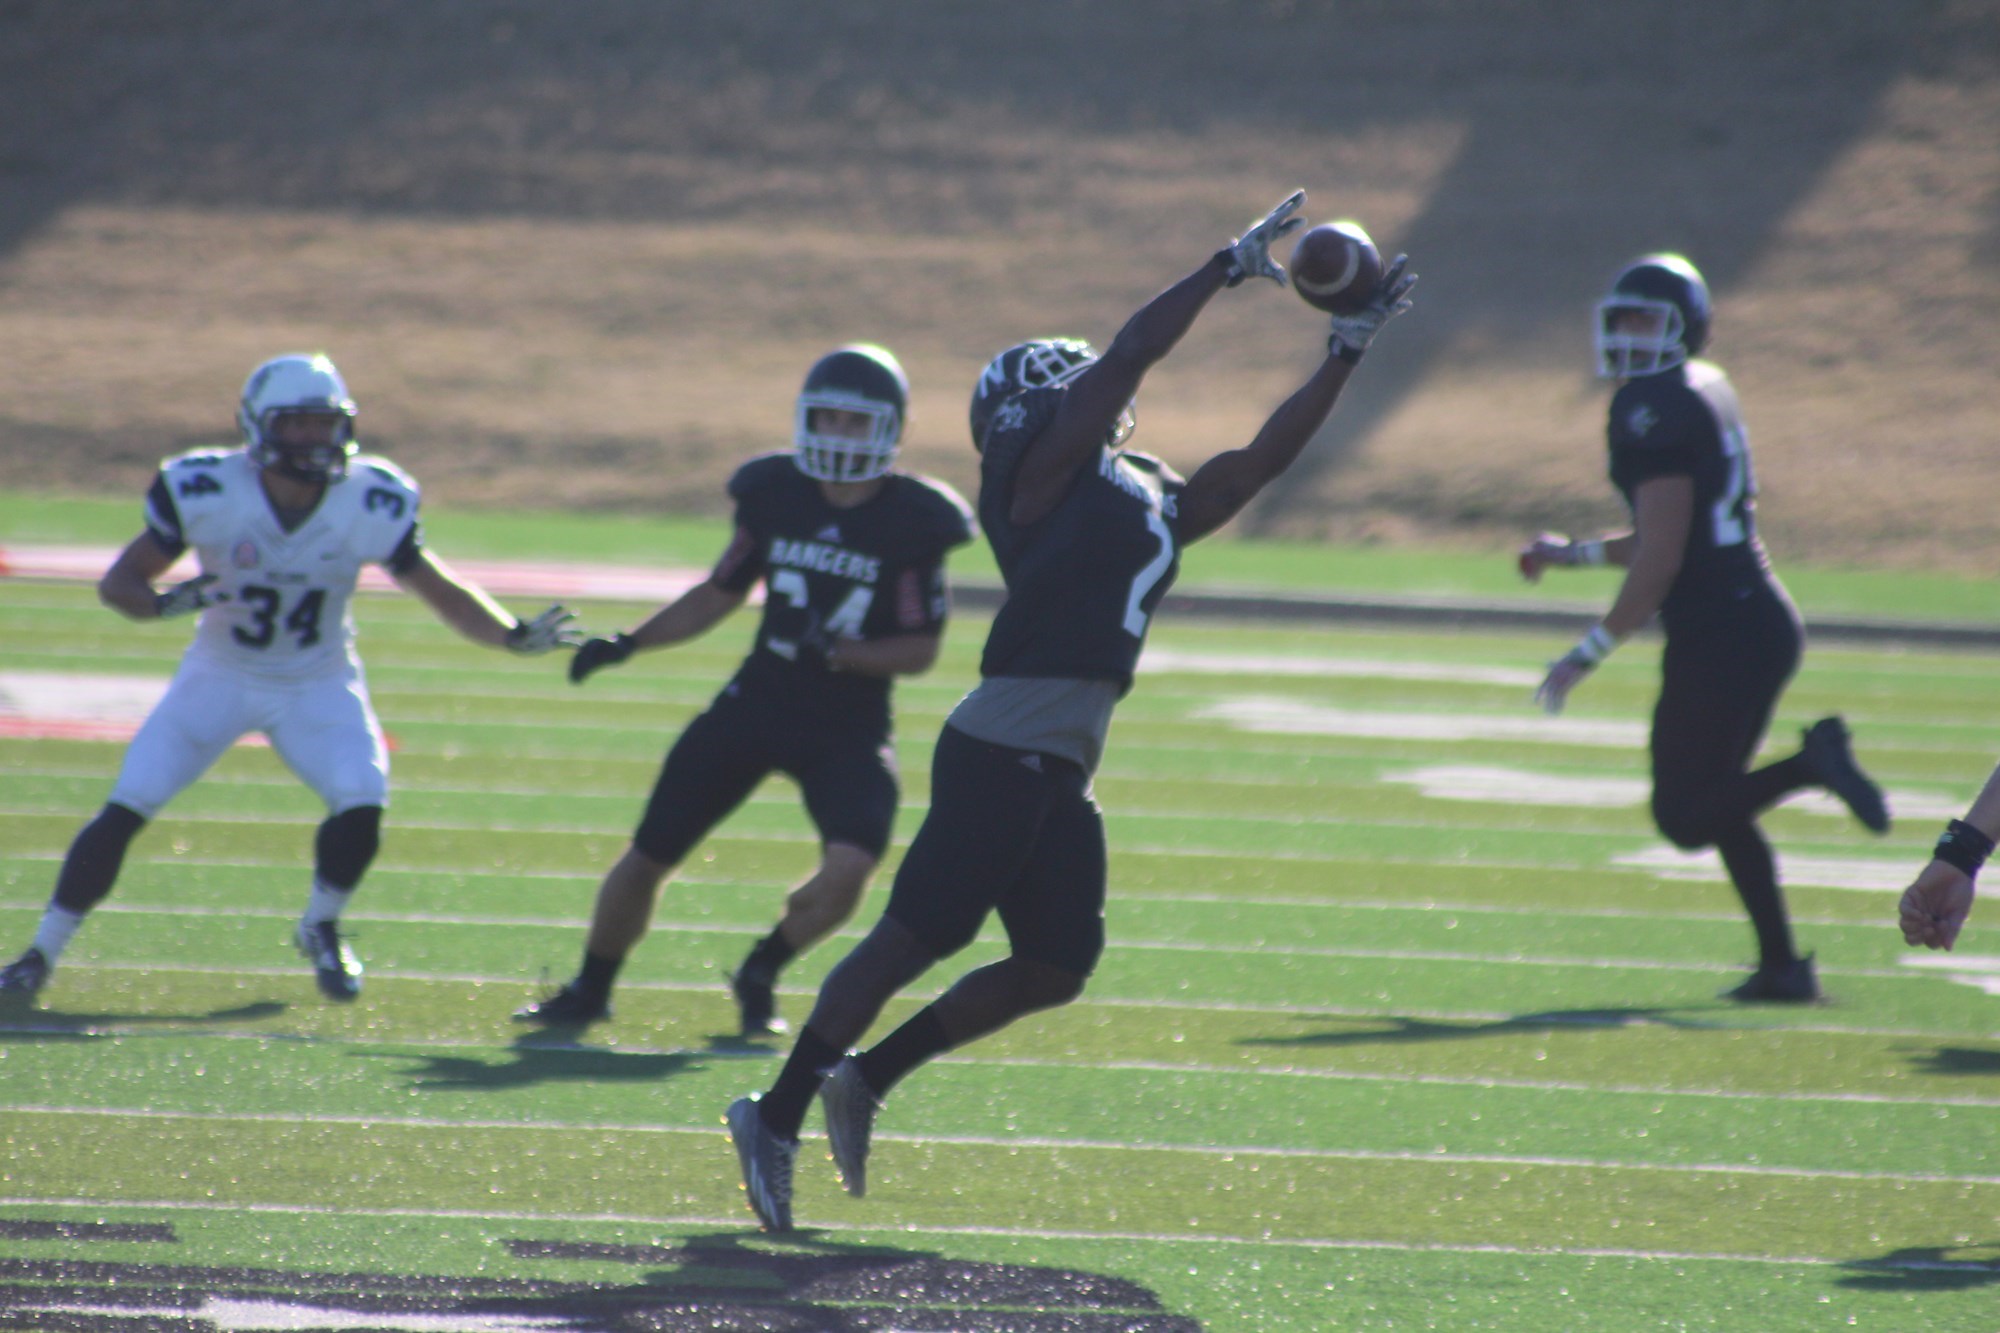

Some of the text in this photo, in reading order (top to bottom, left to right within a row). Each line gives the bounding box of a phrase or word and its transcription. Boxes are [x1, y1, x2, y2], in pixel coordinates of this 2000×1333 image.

[769, 538, 882, 584] RANGERS
[1122, 510, 1174, 638] 2
[231, 585, 326, 649] 34
